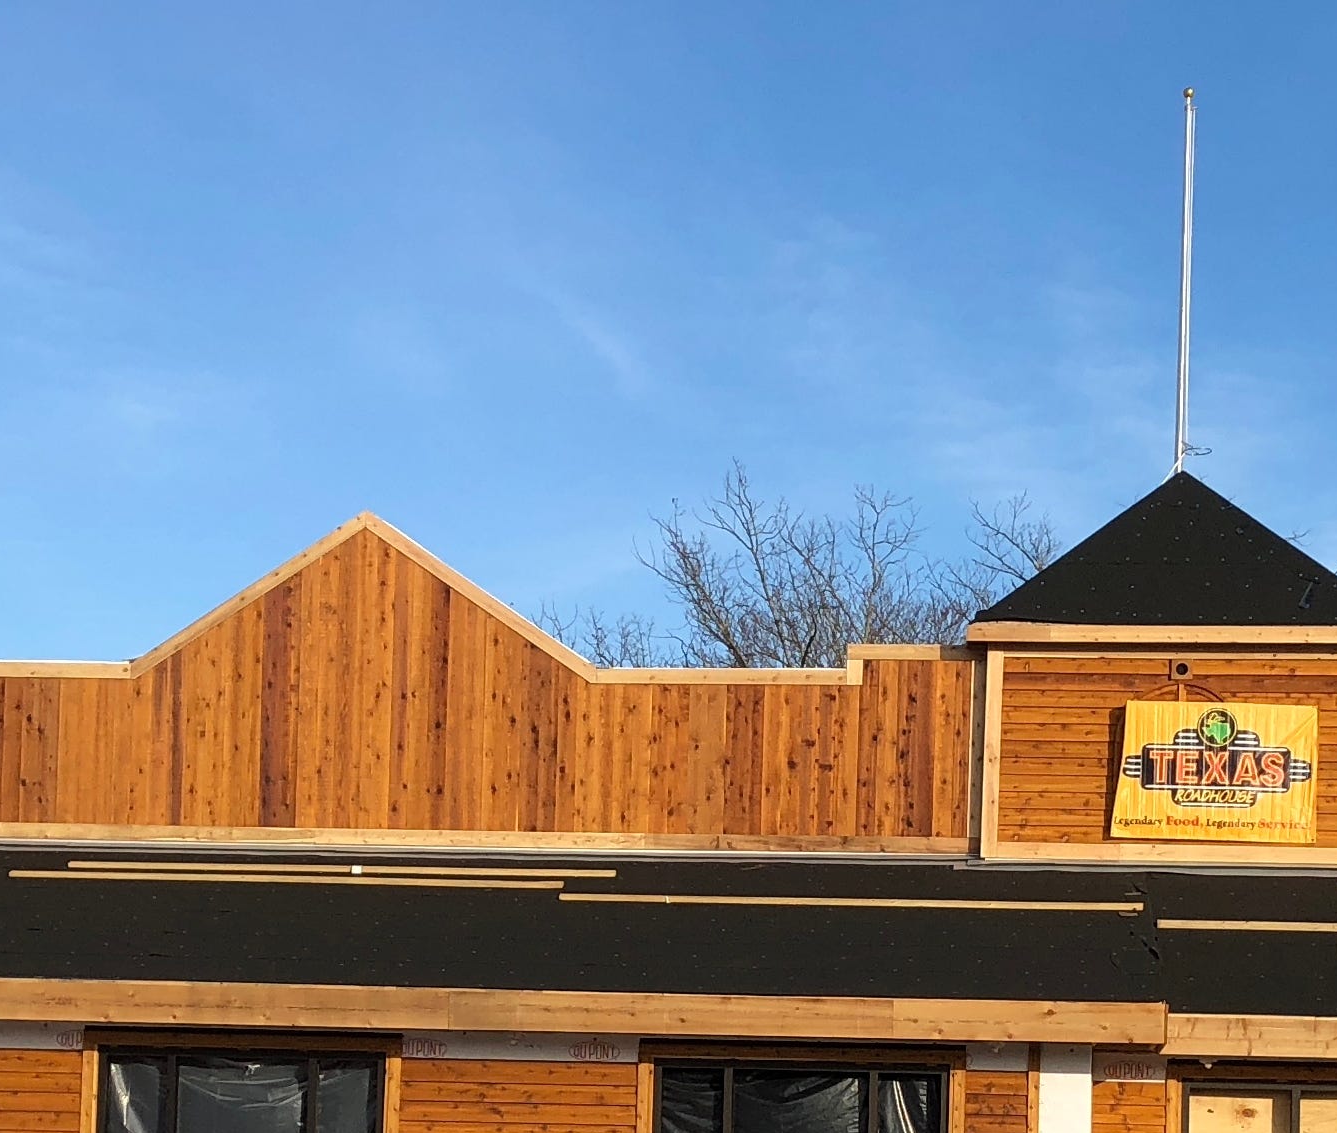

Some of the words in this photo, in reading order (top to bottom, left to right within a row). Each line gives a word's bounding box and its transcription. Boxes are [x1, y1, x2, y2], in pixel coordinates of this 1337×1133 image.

[1149, 750, 1285, 787] TEXAS
[1174, 789, 1256, 805] ROADHOUSE
[1113, 816, 1163, 828] Legendary
[1166, 816, 1204, 829] Food,
[1206, 818, 1256, 830] Legendary
[61, 1030, 83, 1047] DUP
[573, 1041, 615, 1060] DUPONT
[1107, 1061, 1152, 1080] DUPONT
